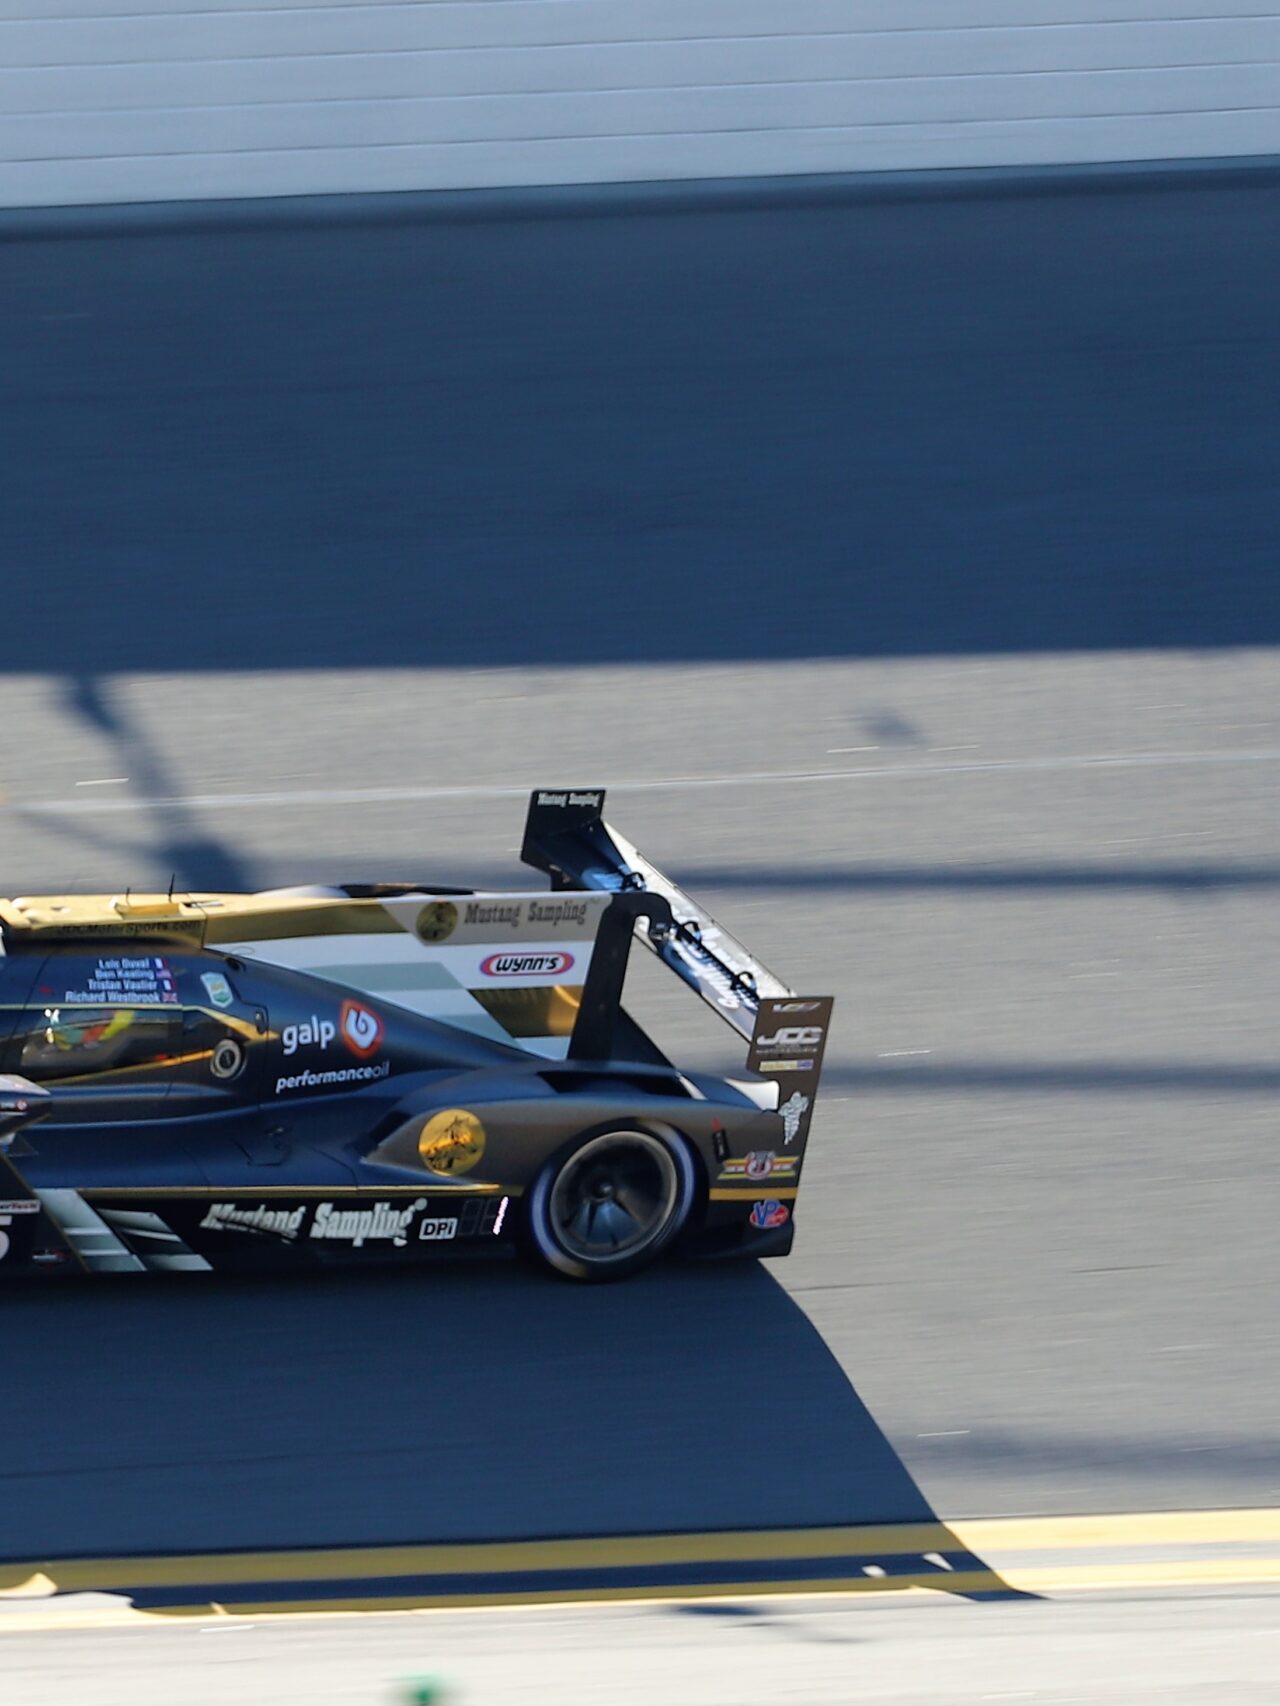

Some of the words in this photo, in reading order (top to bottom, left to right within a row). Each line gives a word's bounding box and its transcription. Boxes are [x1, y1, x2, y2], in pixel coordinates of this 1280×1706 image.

[536, 792, 567, 808] Mustang
[568, 791, 601, 808] Sampling
[464, 902, 521, 928] Mustang
[527, 899, 587, 926] Sampling
[64, 990, 106, 1002] Richard
[107, 990, 161, 1002] Westbrook
[87, 978, 122, 990] Tristan
[281, 1014, 336, 1056] galp
[275, 1060, 390, 1094] performanceoil
[199, 1203, 306, 1245] Mustang
[310, 1202, 417, 1247] Sampling
